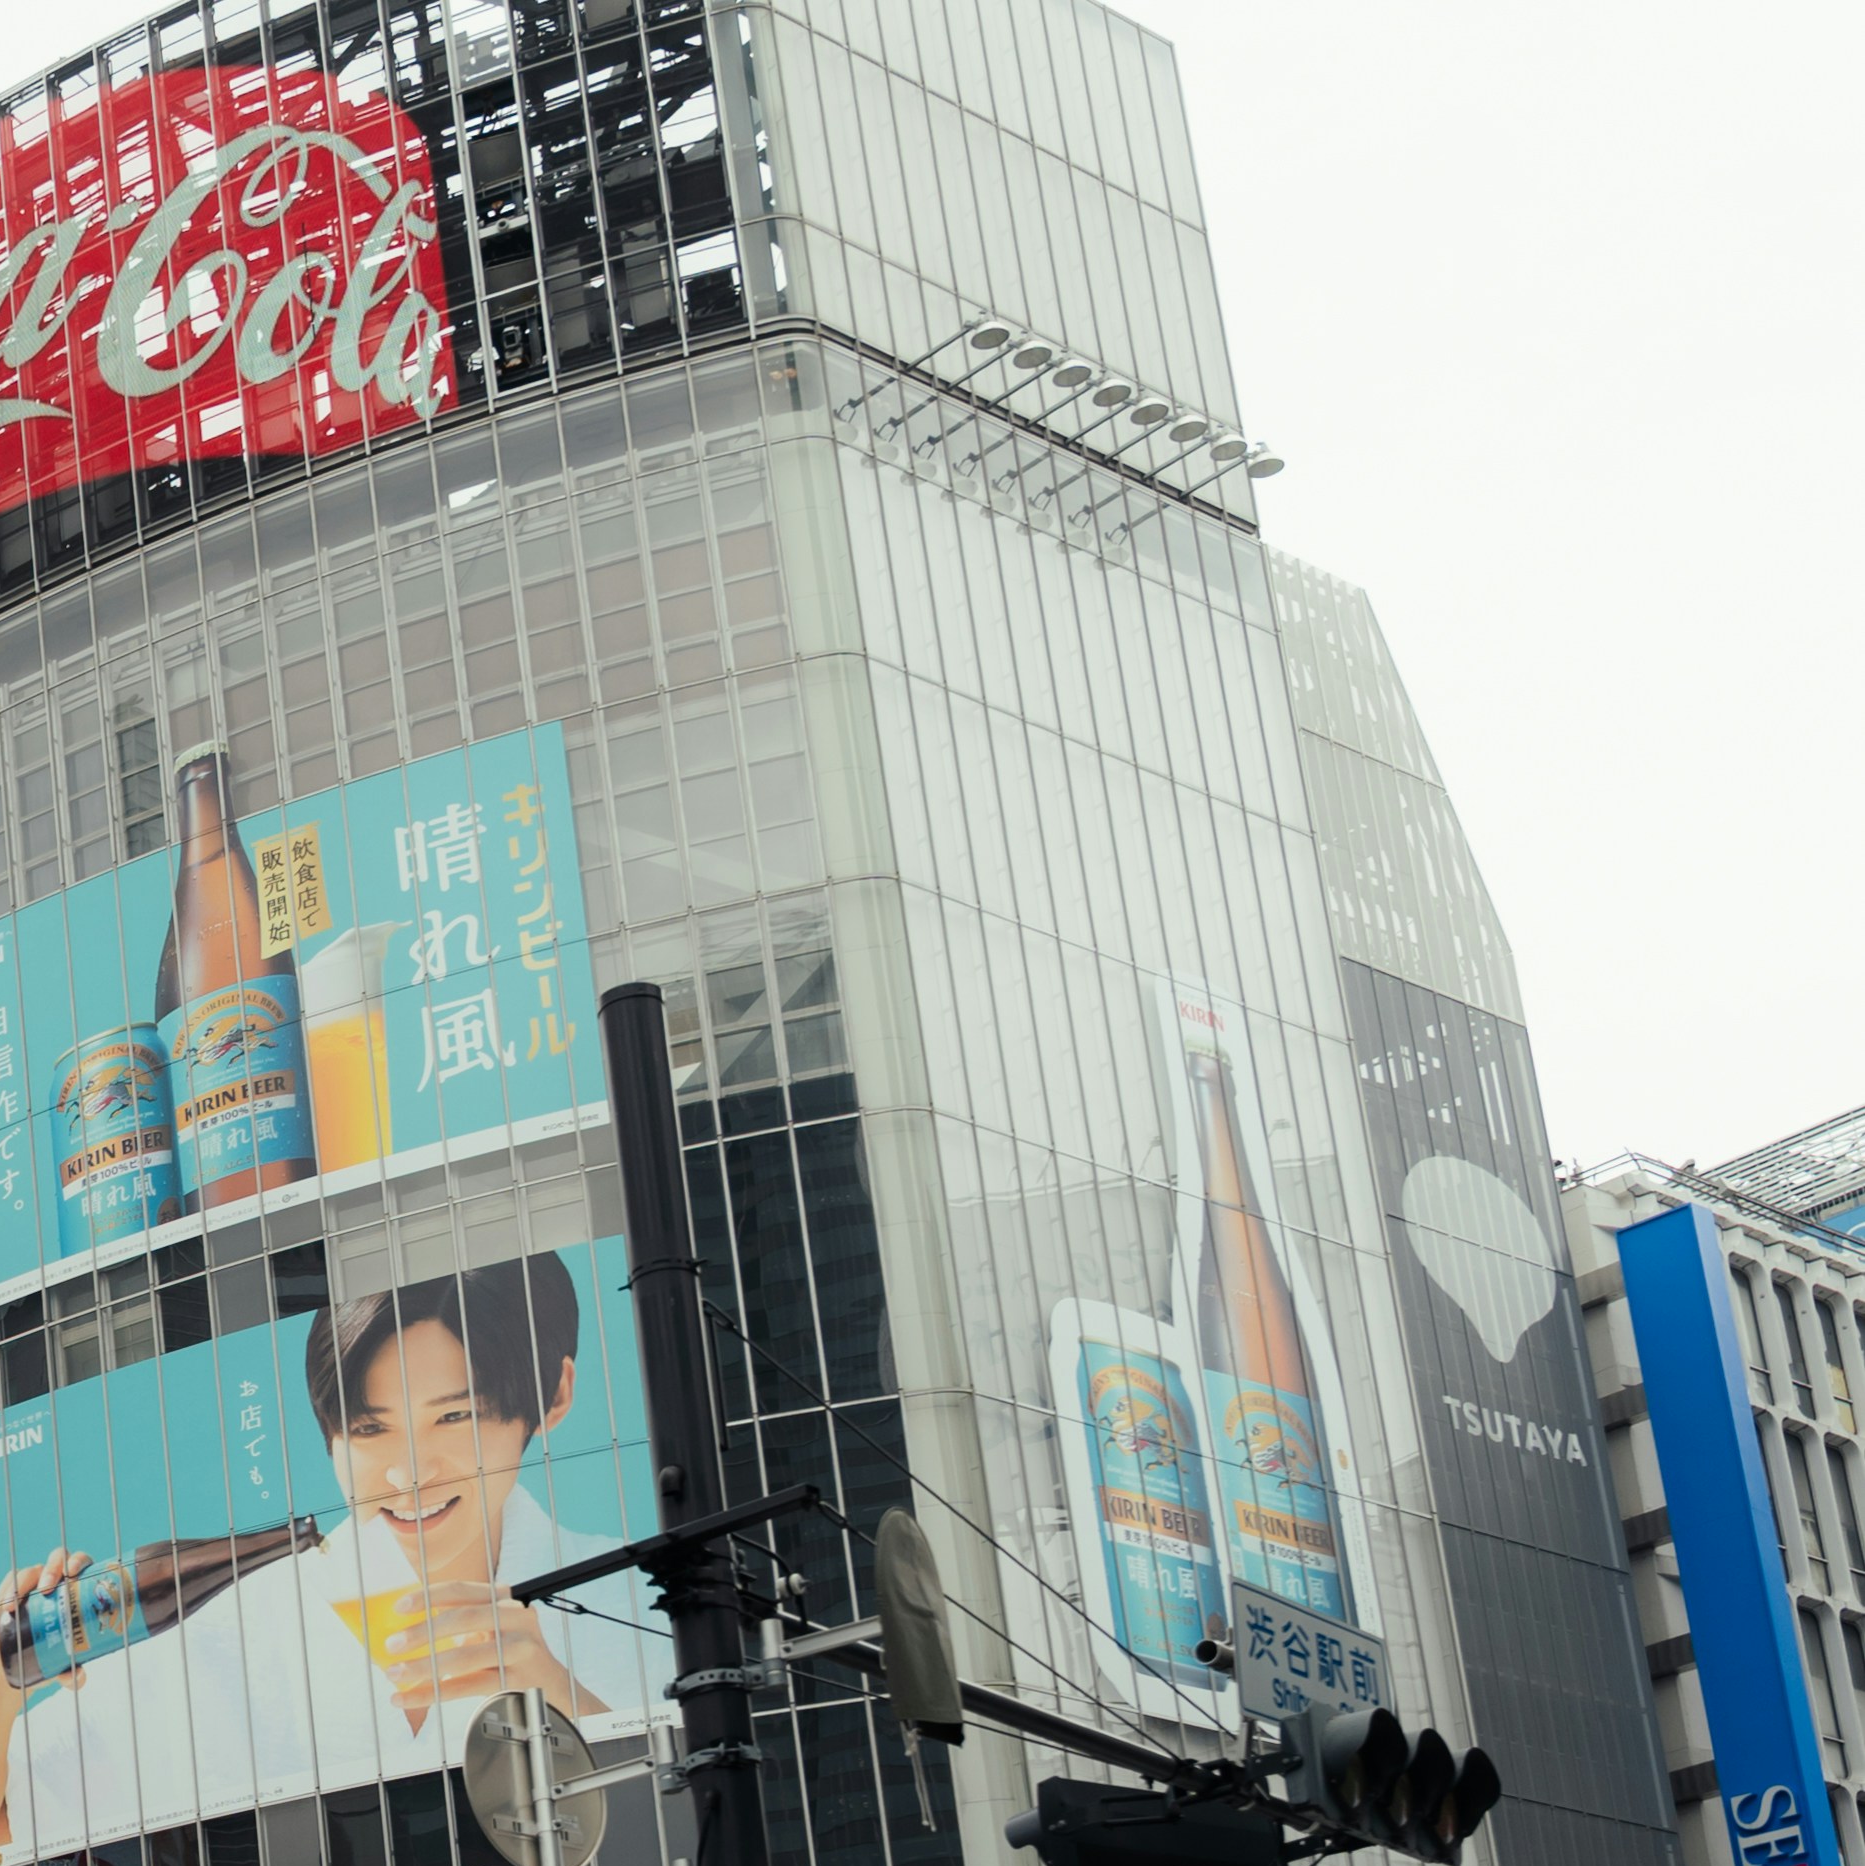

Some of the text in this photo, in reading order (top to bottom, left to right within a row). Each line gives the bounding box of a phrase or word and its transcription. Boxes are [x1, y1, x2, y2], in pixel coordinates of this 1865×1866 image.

[260, 847, 293, 947] 販売開始
[291, 838, 320, 930] 飲食店で
[501, 784, 576, 1063] キリンビール
[393, 803, 516, 1093] 晴れ風
[1177, 999, 1227, 1034] KIRIN
[183, 1088, 237, 1122] KIRIN
[199, 1115, 279, 1159] 晴れ風
[66, 1143, 117, 1180] KIRIN
[81, 1172, 157, 1217] 晴れ風
[238, 1378, 272, 1502] お店でも。
[1442, 1394, 1589, 1469] TSUTAYA
[1108, 1495, 1157, 1526] KIRIN
[1242, 1507, 1289, 1540] KIRIN
[1125, 1554, 1197, 1601] 晴れ風
[1245, 1602, 1382, 1708] 渋谷駅前
